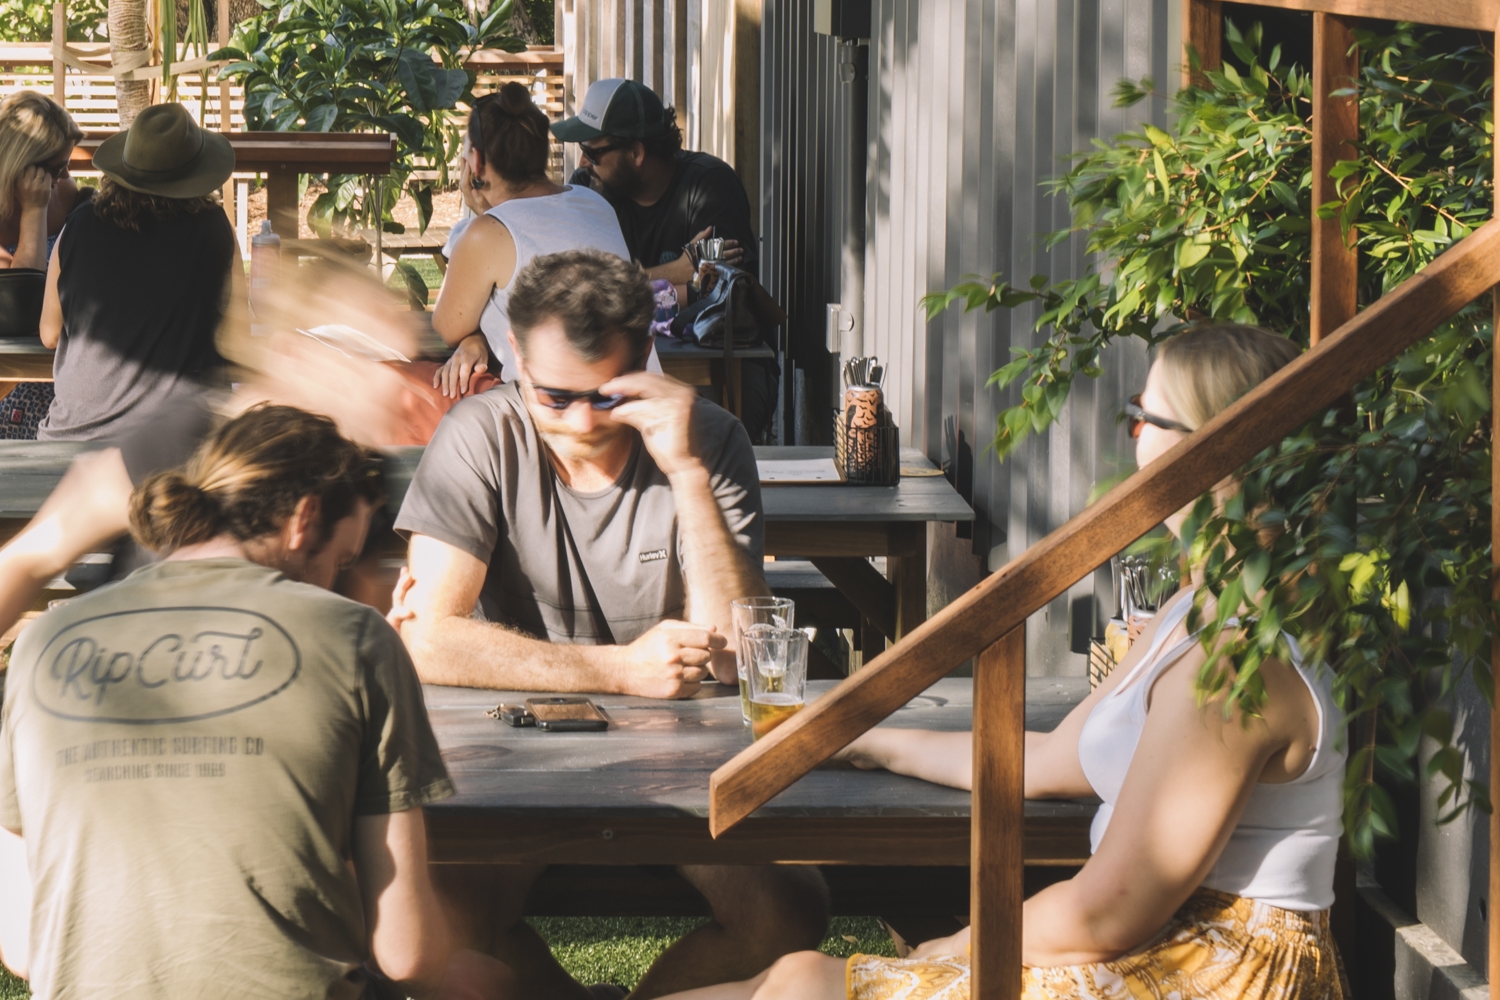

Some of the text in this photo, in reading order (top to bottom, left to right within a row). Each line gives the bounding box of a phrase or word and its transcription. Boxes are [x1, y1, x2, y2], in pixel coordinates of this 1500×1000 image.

[639, 550, 660, 563] Hurley
[50, 626, 264, 706] Rip Curl
[56, 745, 79, 768] THE
[83, 737, 166, 761] AUTHENTIC
[172, 736, 238, 756] SURFING
[85, 761, 226, 783] SEARCHING SINCE 1969
